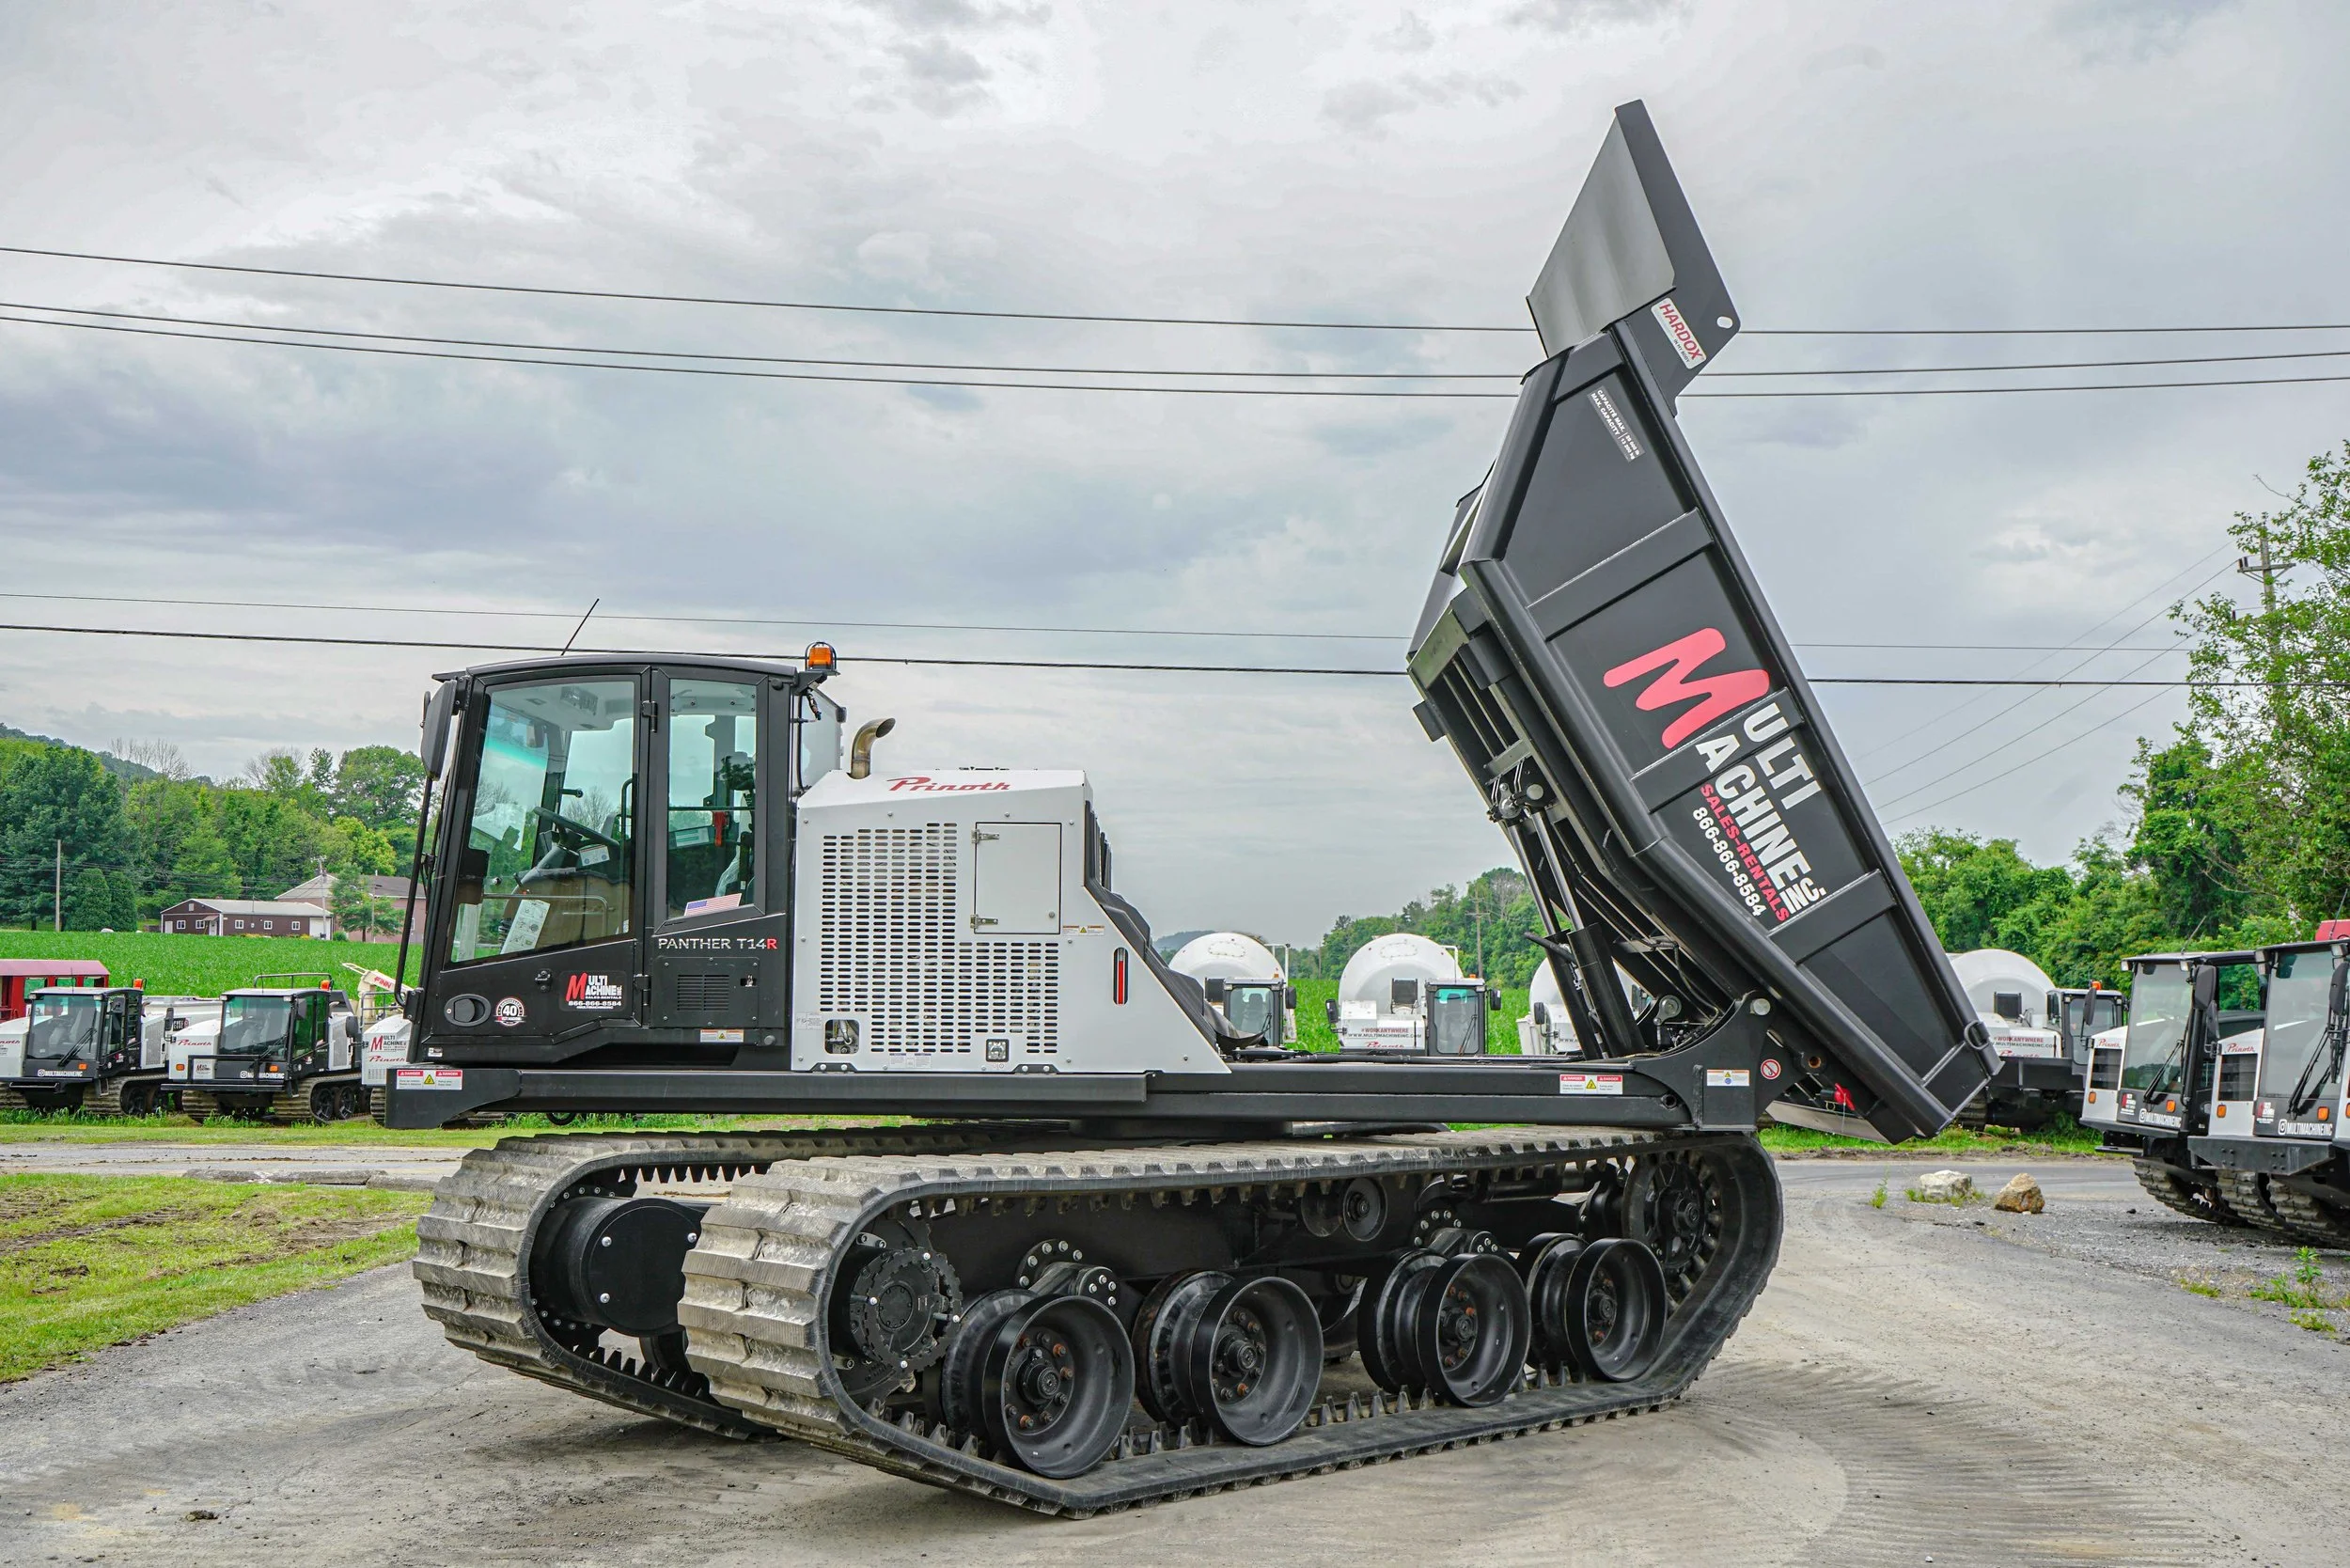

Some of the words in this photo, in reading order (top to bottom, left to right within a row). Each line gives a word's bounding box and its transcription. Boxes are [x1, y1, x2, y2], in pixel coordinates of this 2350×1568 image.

[1659, 304, 1703, 360] HARDOX
[1590, 392, 1602, 408] MAX.
[1600, 407, 1620, 435] CAPACITY
[1597, 389, 1618, 418] CAPACITÉ
[1614, 416, 1625, 432] MAX.
[886, 776, 1011, 792] Prinoth
[1693, 807, 1767, 917] 866-866-8584
[1700, 784, 1791, 922] SALES-RENTALS
[1778, 877, 1827, 915] INC.
[658, 938, 731, 949] PANTHER
[736, 938, 777, 949] T14R
[374, 977, 393, 990] FINN
[503, 1005, 517, 1017] 40
[2286, 1121, 2333, 1137] MULTIMACHINEINC
